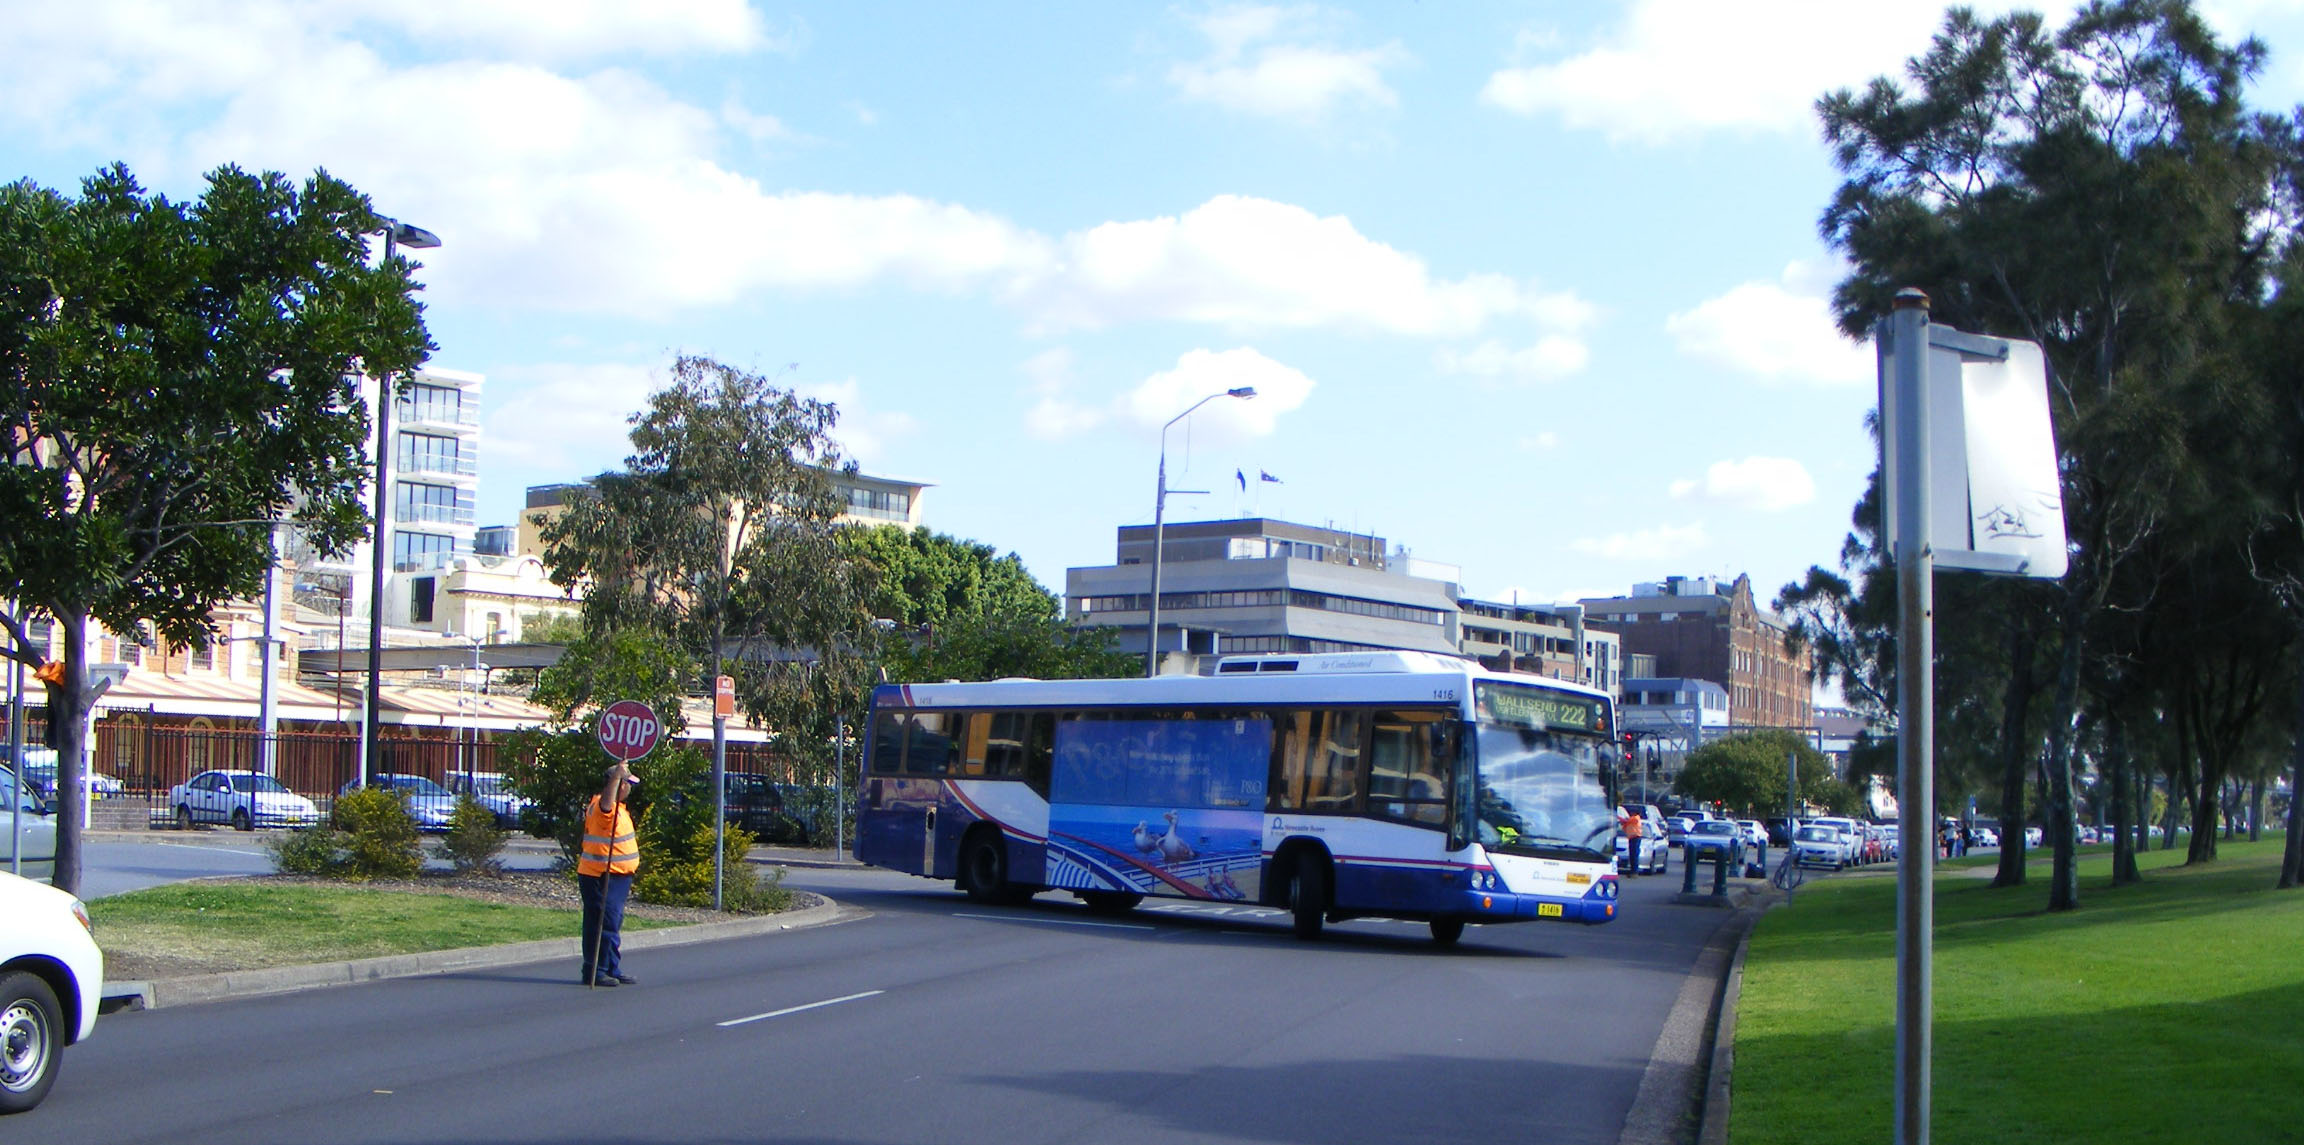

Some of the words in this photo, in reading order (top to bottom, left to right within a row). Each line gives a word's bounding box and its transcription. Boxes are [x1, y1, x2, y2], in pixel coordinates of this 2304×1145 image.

[1433, 689, 1453, 700] 1416
[1496, 695, 1557, 713] WALLSEND
[1561, 704, 1587, 725] 222
[602, 712, 656, 747] STOP
